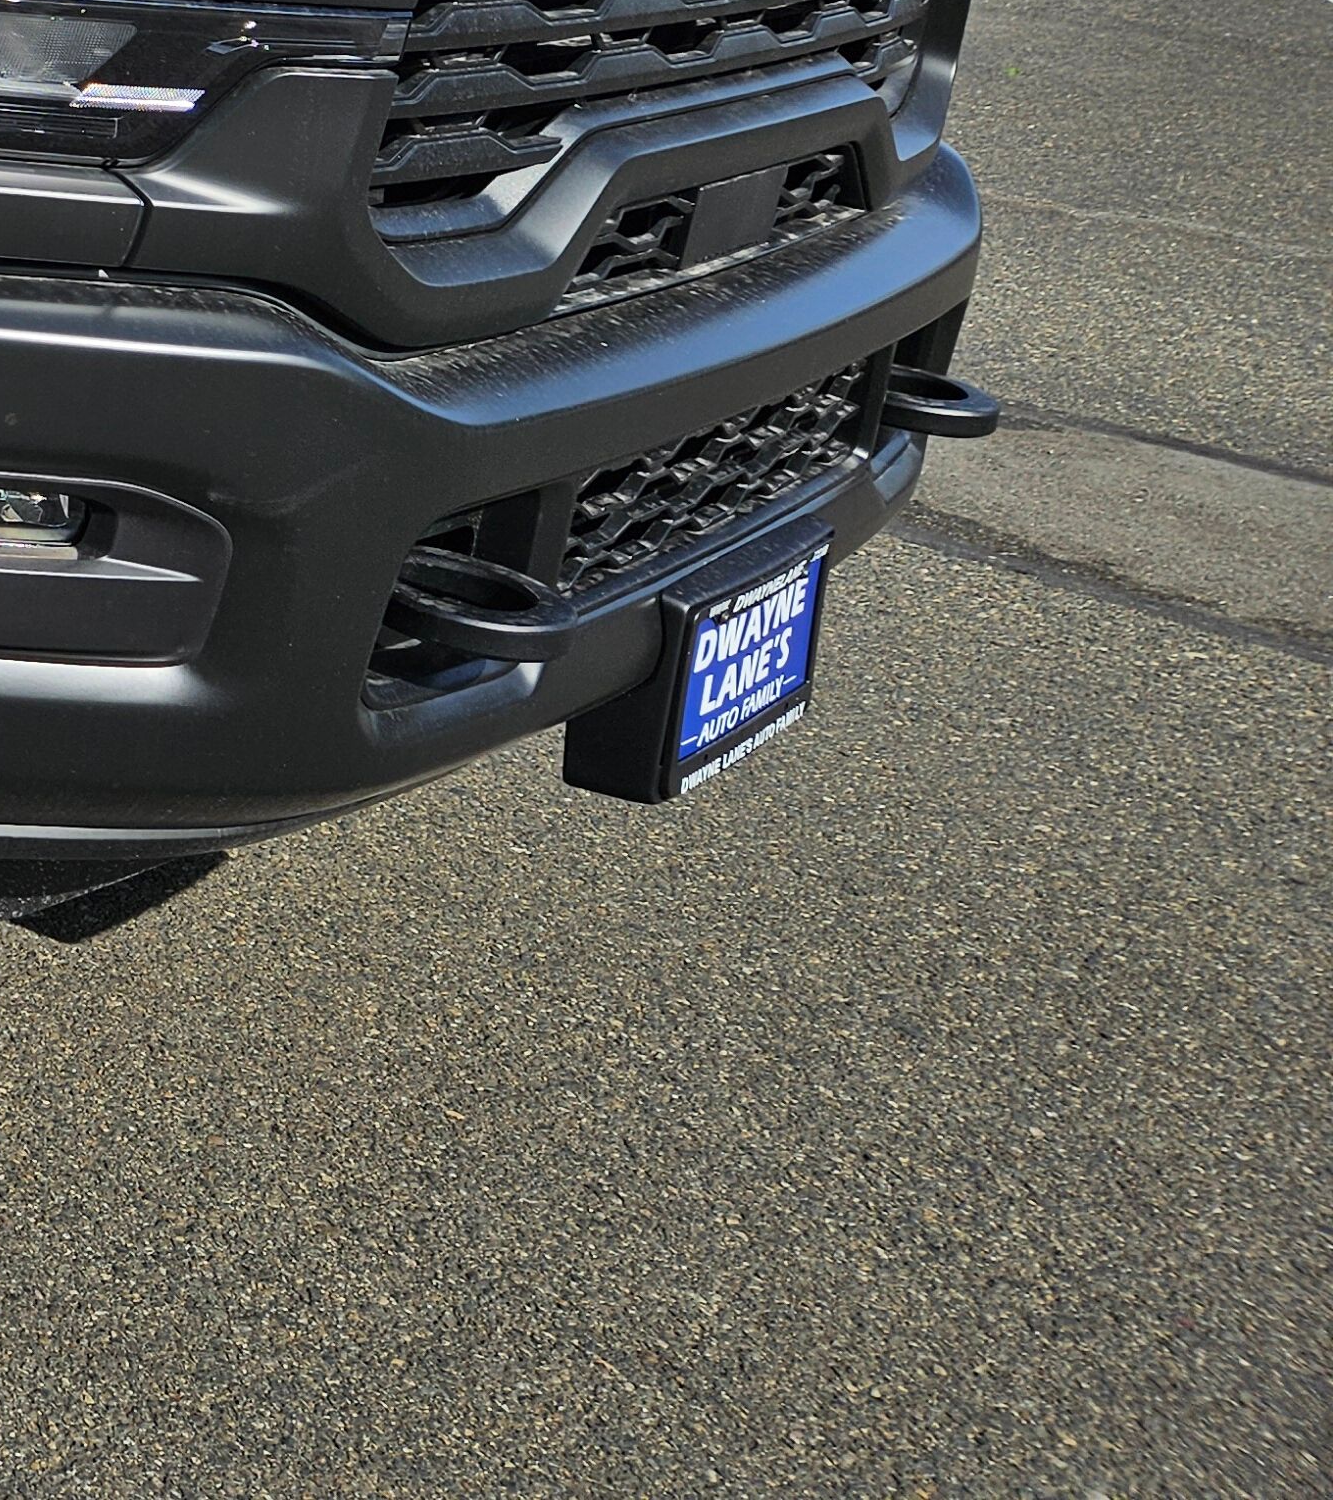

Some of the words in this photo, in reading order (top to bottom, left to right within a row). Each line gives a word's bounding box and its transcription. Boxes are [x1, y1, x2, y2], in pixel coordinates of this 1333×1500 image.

[693, 578, 810, 674] DWAYNE
[699, 627, 793, 717] LANE'S
[680, 757, 722, 795] DWAYNE
[753, 722, 776, 749] AUTO
[776, 701, 806, 734] FAMILY
[696, 705, 740, 748] AUTO
[740, 674, 785, 721] FAMILY
